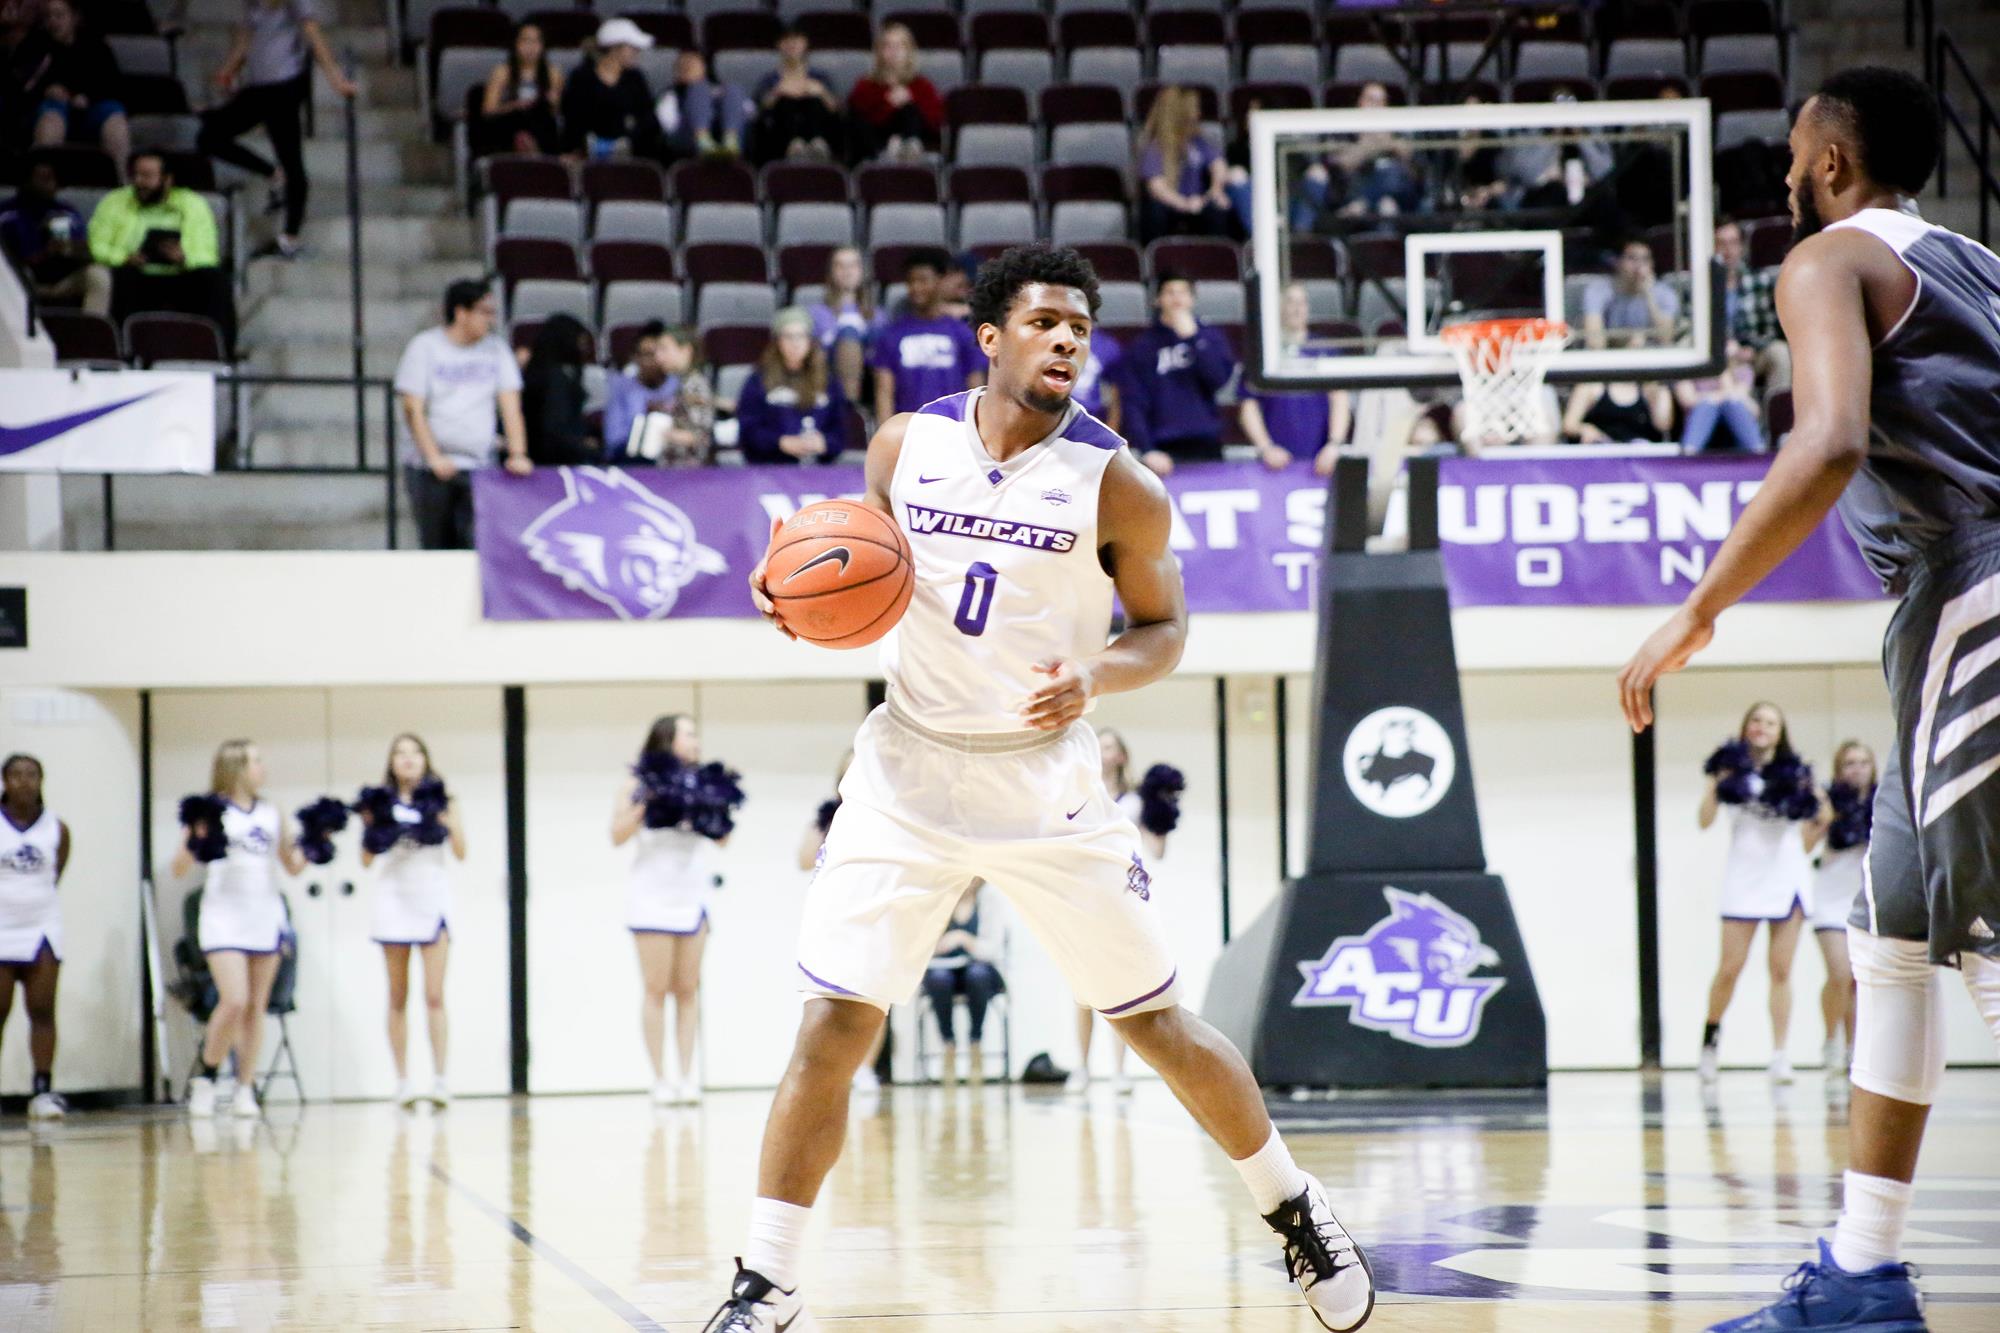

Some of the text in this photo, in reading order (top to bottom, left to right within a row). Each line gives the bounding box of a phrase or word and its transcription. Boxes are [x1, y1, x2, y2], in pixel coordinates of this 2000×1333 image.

[907, 505, 1077, 553] WILDCATS
[954, 561, 999, 637] 0
[1313, 946, 1478, 1038] ACU
